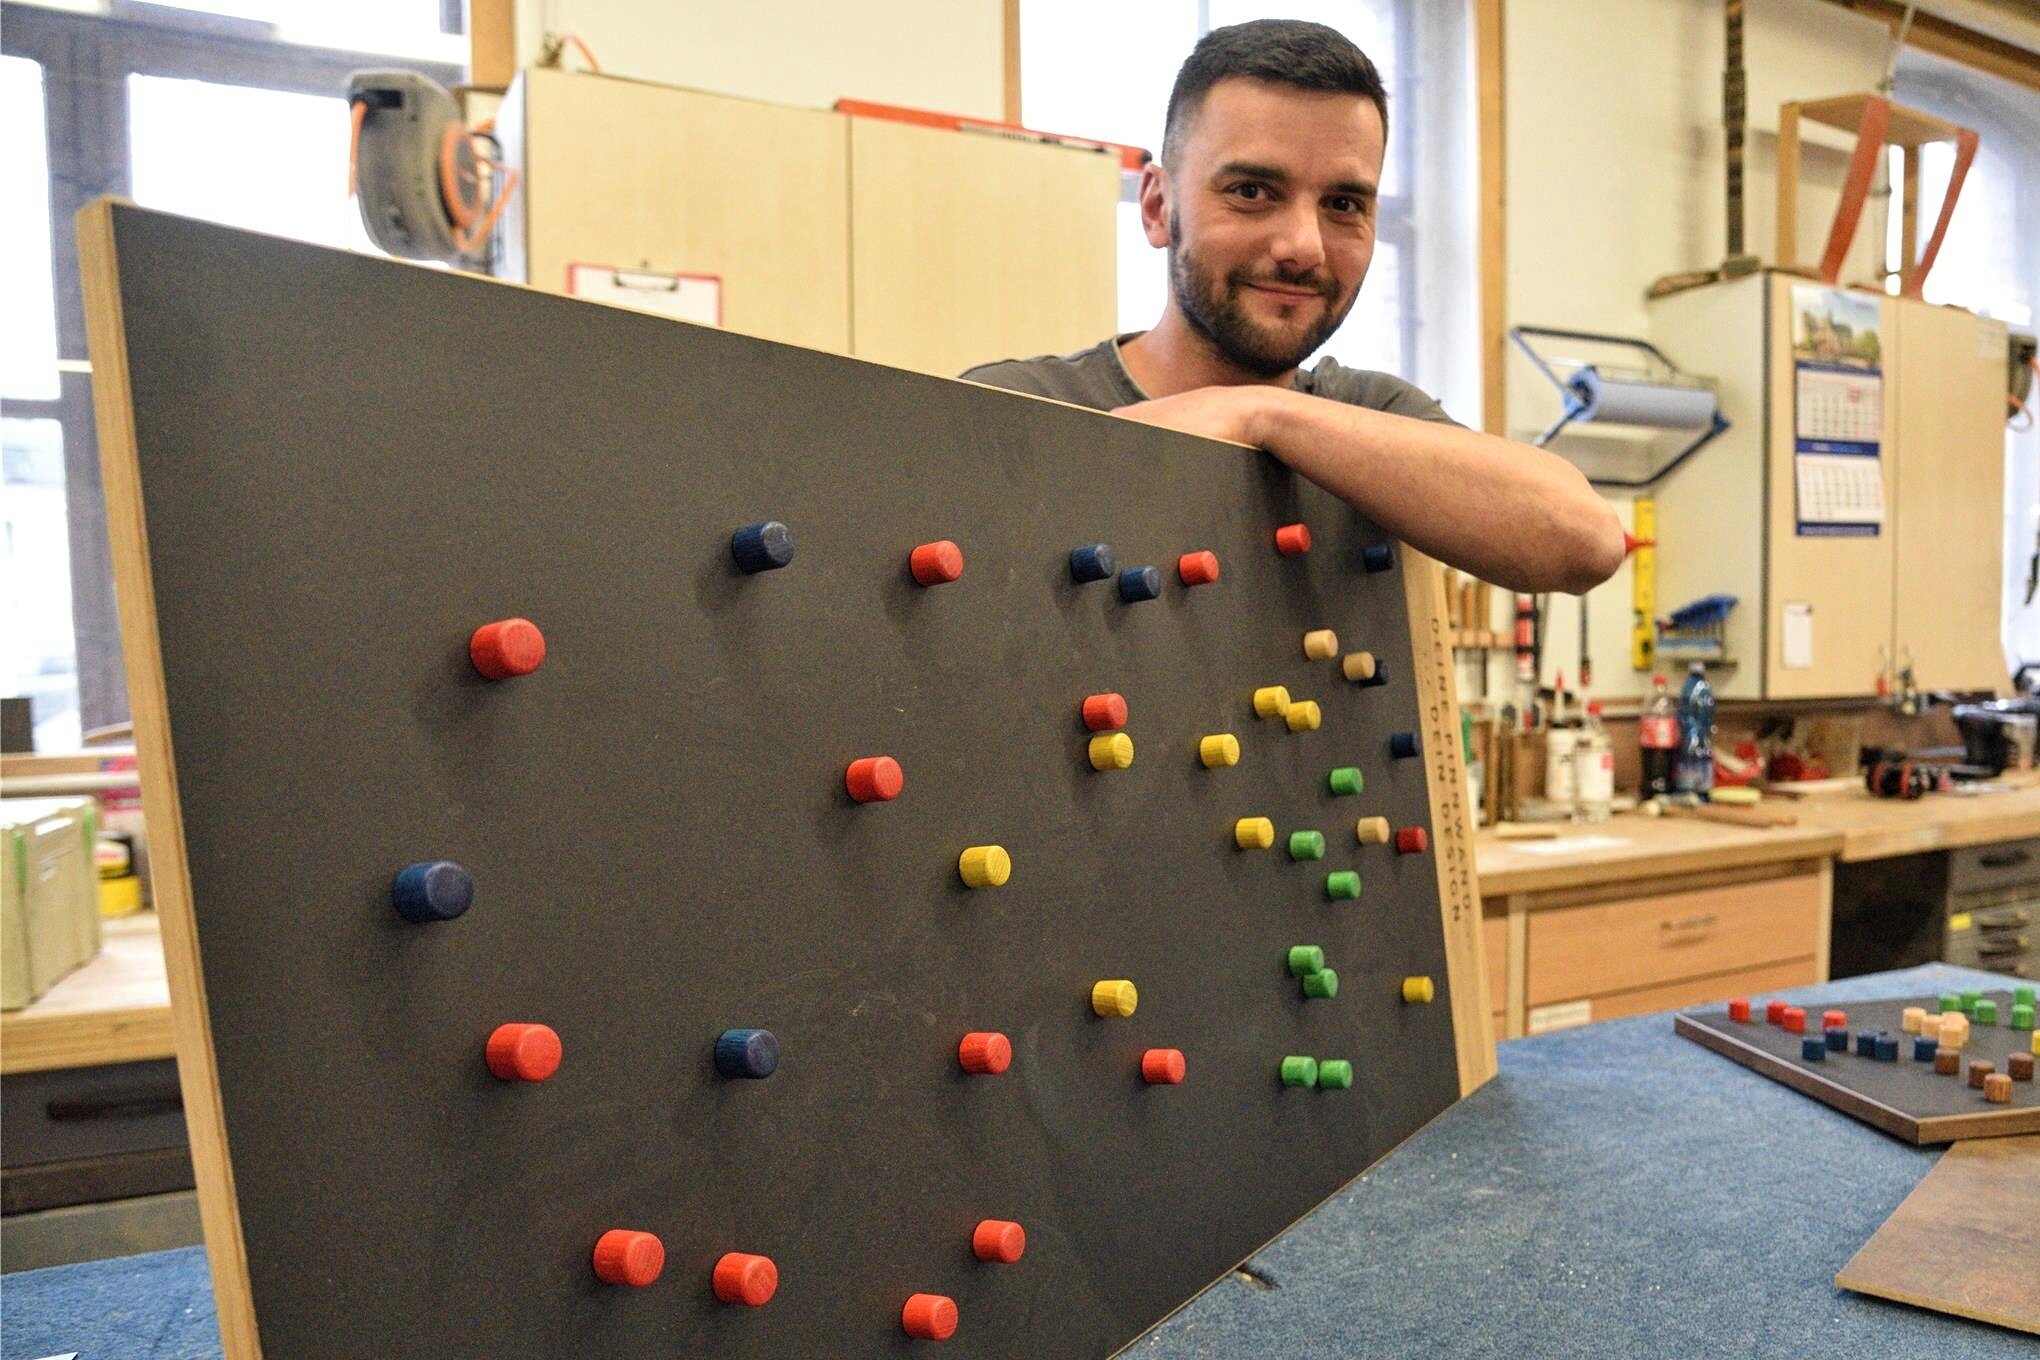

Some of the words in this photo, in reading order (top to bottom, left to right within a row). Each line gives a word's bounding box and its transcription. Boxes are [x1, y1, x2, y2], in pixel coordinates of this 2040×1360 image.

[1431, 618, 1449, 712] DEINE
[1430, 706, 1446, 782] DEIN
[1441, 803, 1460, 923] DESIGN
